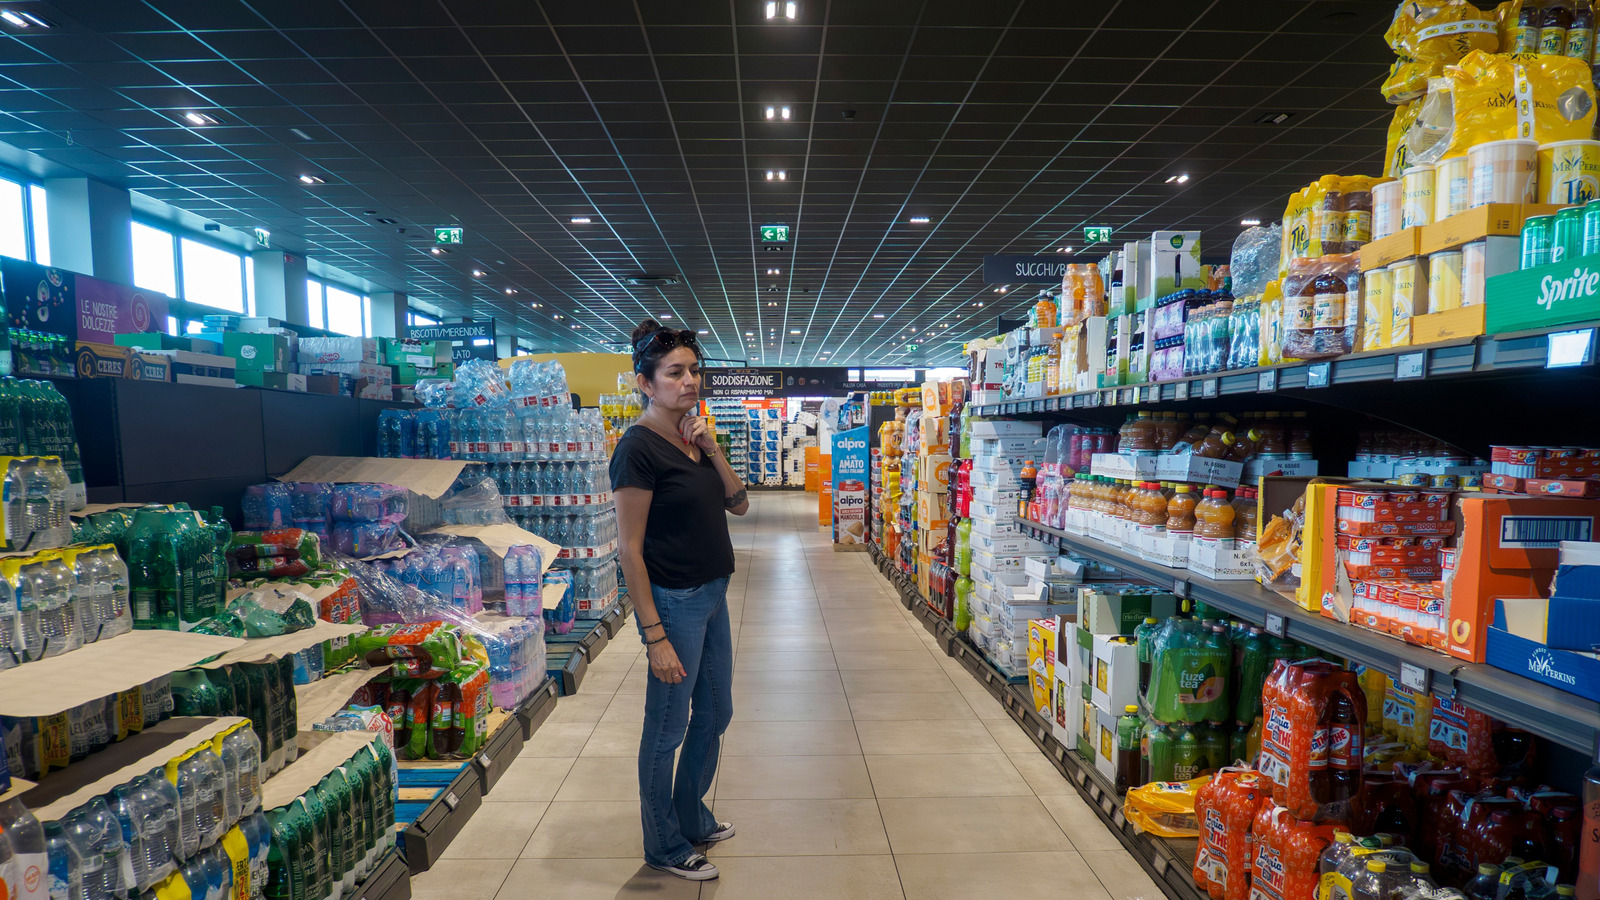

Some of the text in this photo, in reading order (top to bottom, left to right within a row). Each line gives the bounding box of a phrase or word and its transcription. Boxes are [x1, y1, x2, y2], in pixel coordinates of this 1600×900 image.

[1015, 262, 1067, 277] SUCCHI/B
[1537, 267, 1600, 311] Sprite
[80, 299, 119, 320] LE NOSTRE
[81, 316, 117, 334] DOLCEZZE
[410, 326, 486, 339] BISCOTTI/MERENDINE
[97, 360, 122, 375] CERES
[144, 365, 164, 380] CERES
[712, 375, 774, 386] SODDISFAZIONE
[837, 437, 866, 451] alpro
[839, 459, 864, 469] AMATO
[840, 495, 864, 507] alpro
[1180, 670, 1205, 681] fuze
[1528, 658, 1576, 686] MR PERKINS
[1180, 680, 1199, 689] tea
[1173, 763, 1199, 774] fuze
[1173, 772, 1192, 780] tea
